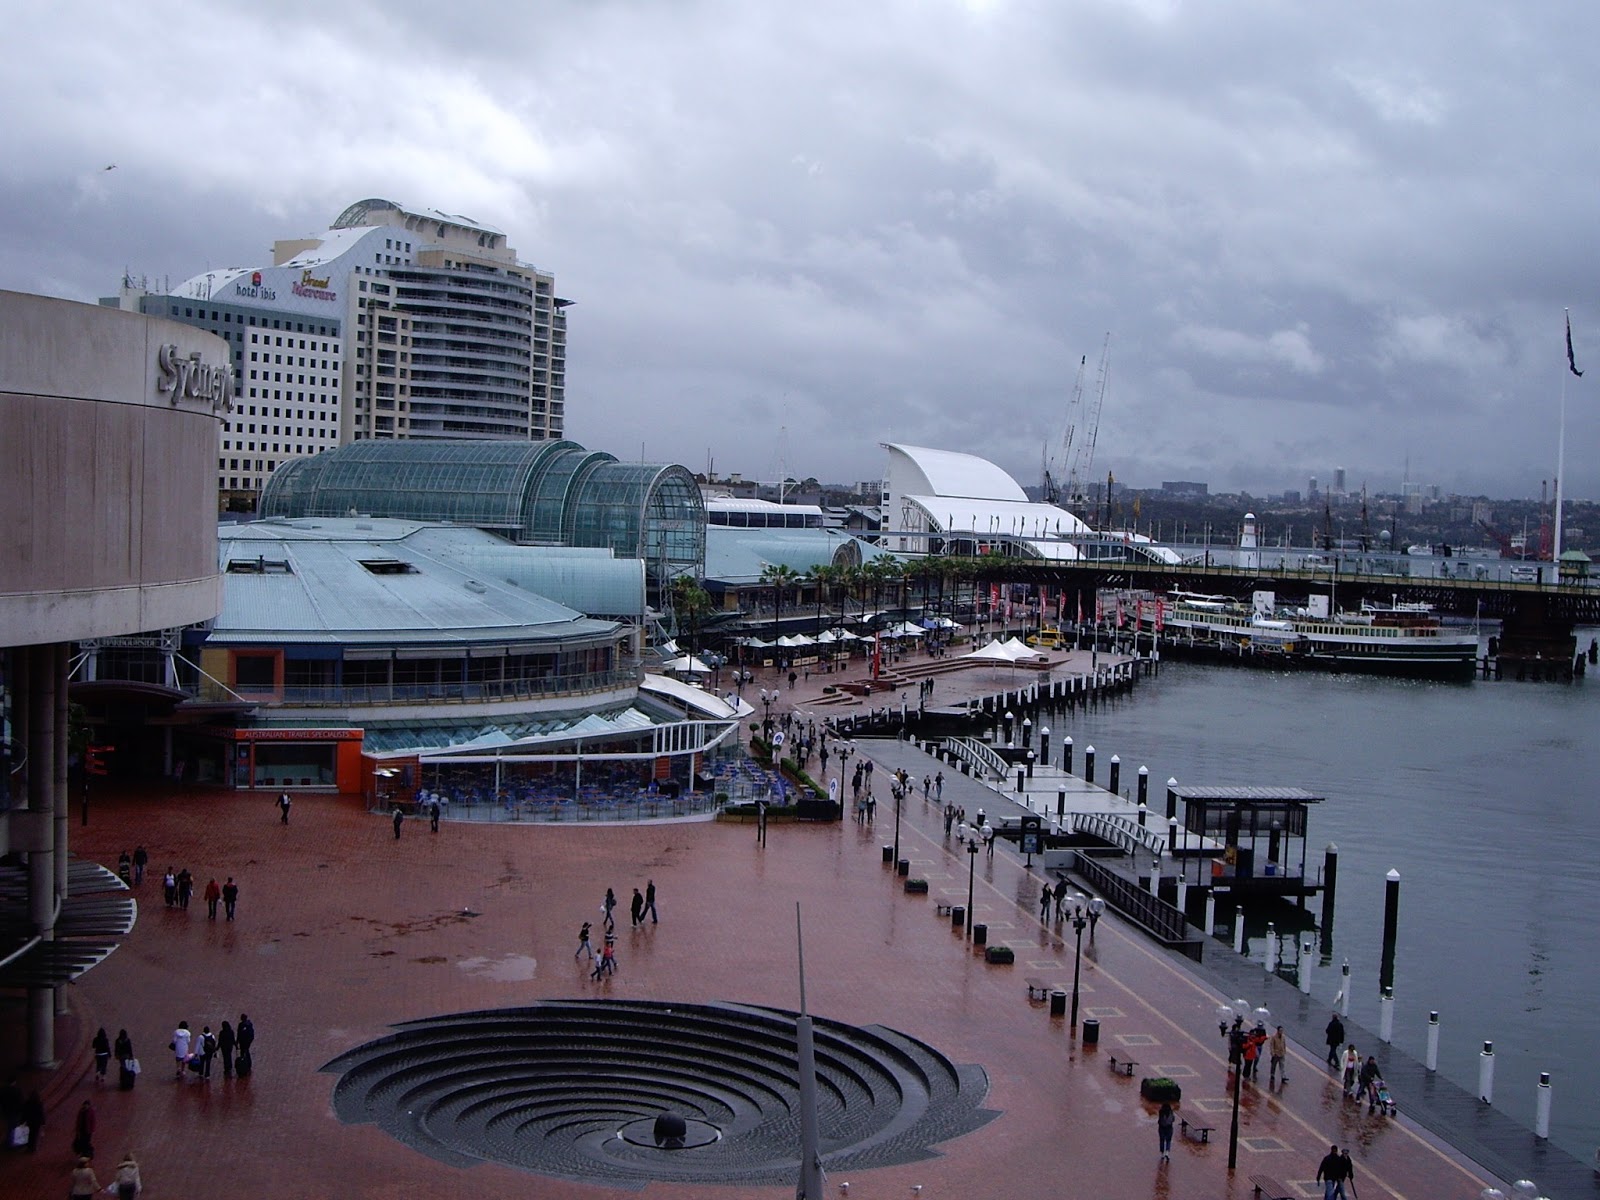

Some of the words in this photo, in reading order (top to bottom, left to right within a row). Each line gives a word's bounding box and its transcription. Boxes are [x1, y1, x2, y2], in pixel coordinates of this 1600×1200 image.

[301, 270, 330, 289] Grand
[236, 283, 258, 298] hotel
[261, 286, 276, 300] ibis
[291, 281, 337, 301] Mercure
[244, 730, 286, 739] AUSTRALIAN
[288, 730, 310, 739] TRAVEL
[312, 730, 350, 739] SPECIALISTS
